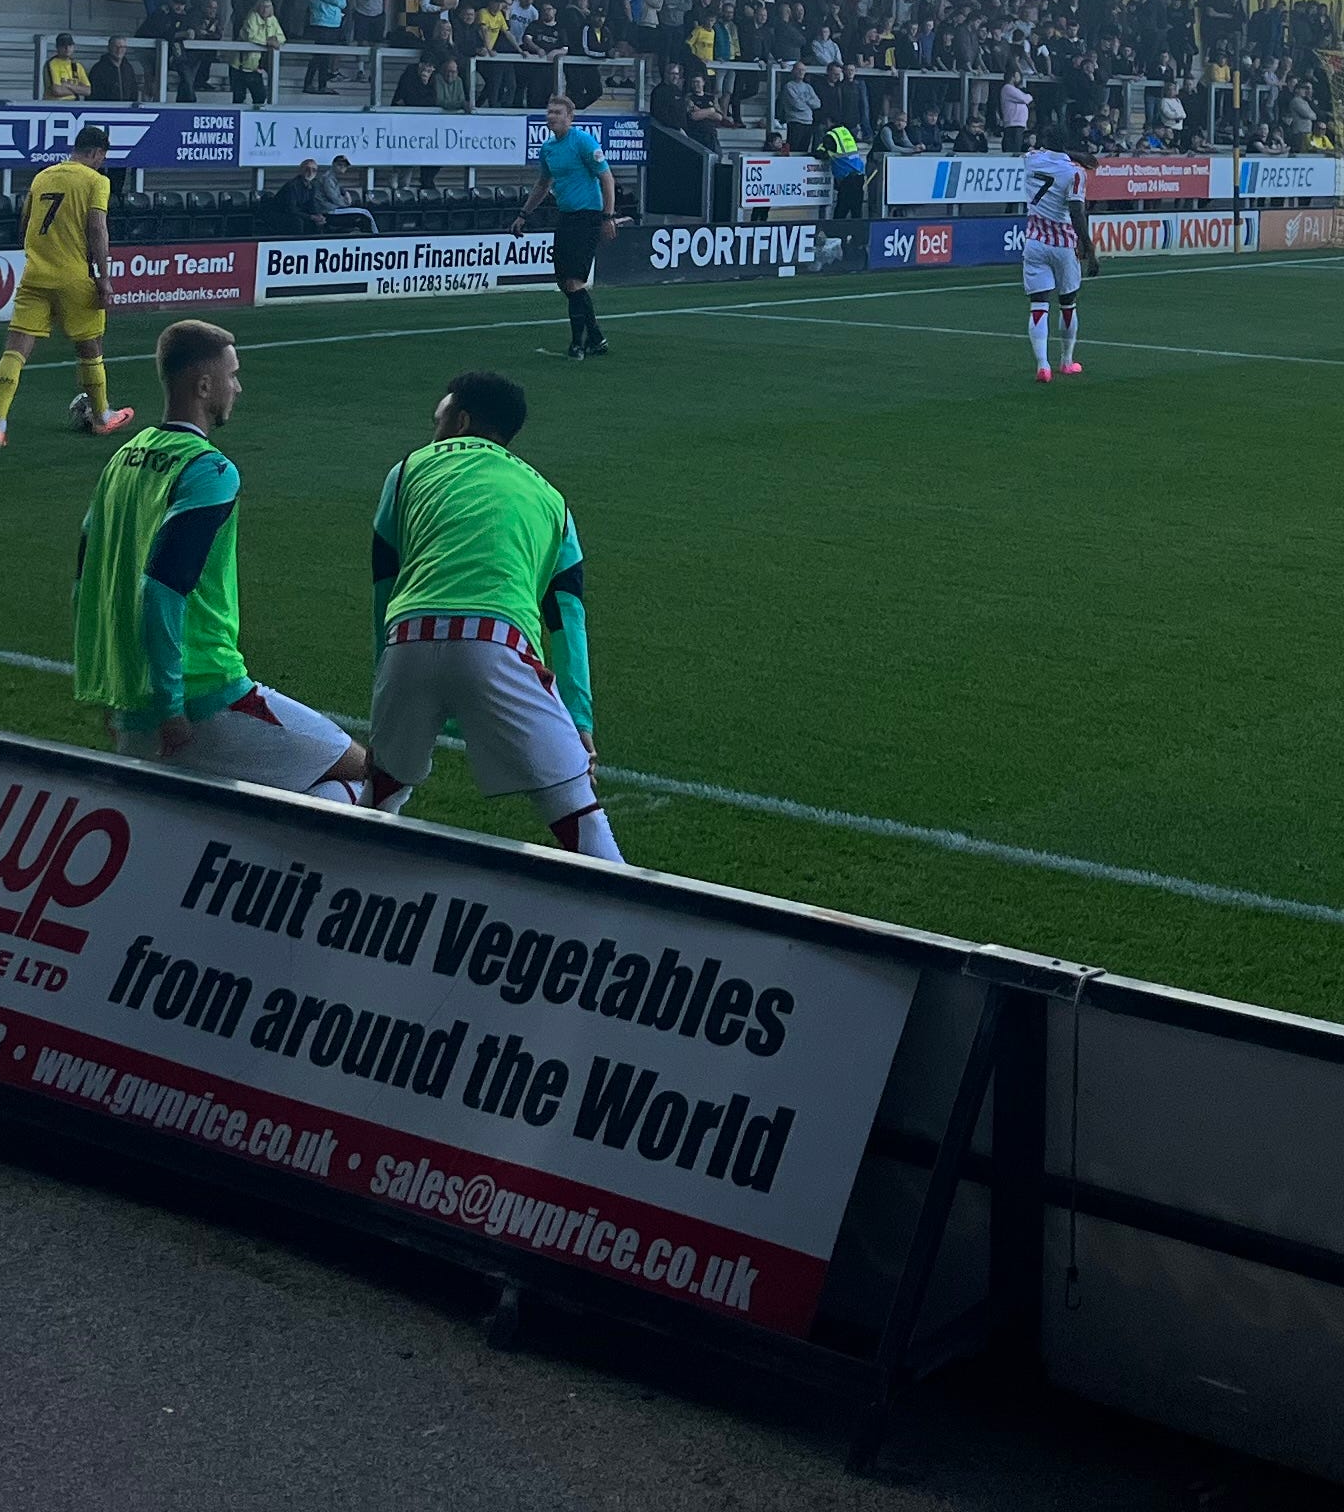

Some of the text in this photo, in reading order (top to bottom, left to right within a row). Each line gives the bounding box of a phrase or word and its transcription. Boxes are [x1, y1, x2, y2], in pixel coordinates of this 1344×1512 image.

[193, 115, 234, 130] BESPOKE
[255, 121, 517, 153] M Murray's Funeral Directors
[181, 130, 234, 145] TEAMWEAR
[176, 146, 234, 162] SPECIALISTS
[745, 166, 763, 183] LCS
[964, 166, 1024, 193] PRESTE
[1030, 171, 1056, 206] 7
[1127, 180, 1180, 195] Open 24 Hours
[1261, 167, 1314, 188] PRESTEC
[745, 183, 802, 197] CONTAINERS
[40, 192, 66, 236] 7
[650, 224, 816, 269] SPORTFIVE
[883, 224, 1026, 263] sky bet sk
[1091, 219, 1161, 253] KNOTT
[130, 254, 170, 277] Our
[174, 251, 235, 275] Team!
[267, 239, 555, 276] Ben Robinson Financial Advis
[108, 287, 240, 305] restchicloadbanks.com
[376, 273, 489, 295] Tel: 01283 564774
[180, 839, 796, 1059] Fruit and Vegetables
[15, 962, 69, 994] LTD
[107, 935, 797, 1194] from around the World
[31, 1044, 339, 1178] www.gwprice.co.uk
[369, 1153, 760, 1312] sales@gwprice.co.uk
